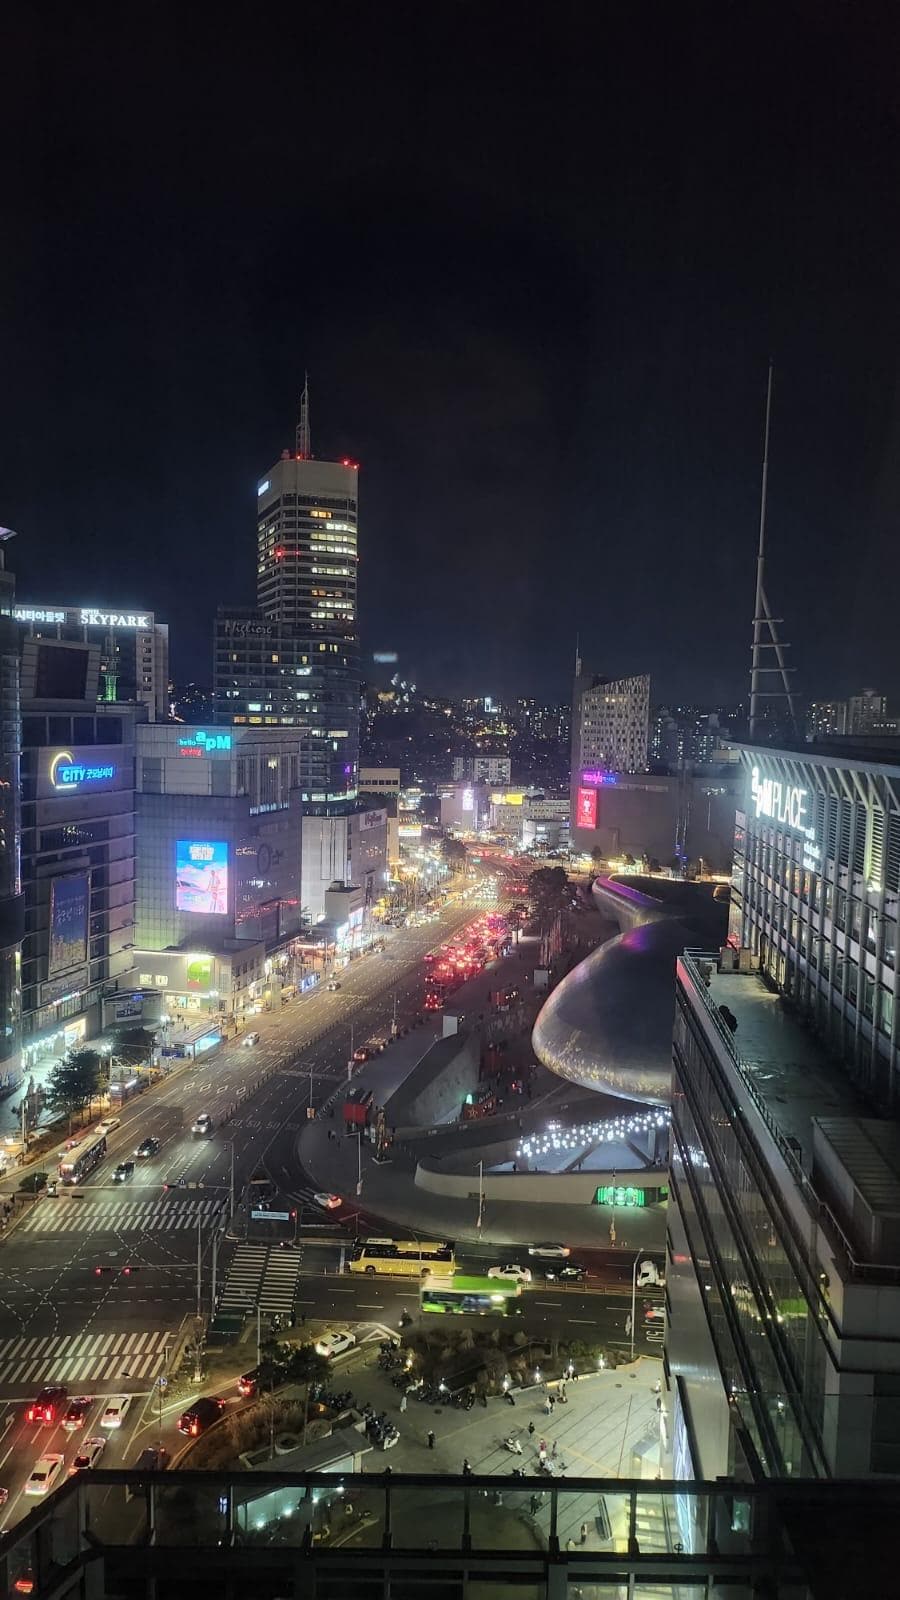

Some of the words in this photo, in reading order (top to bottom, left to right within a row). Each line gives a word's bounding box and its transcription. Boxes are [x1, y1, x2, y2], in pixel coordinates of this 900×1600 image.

[80, 614, 150, 628] SKYPARK
[195, 731, 231, 751] apM
[62, 768, 86, 782] CITY
[772, 781, 808, 832] PLACE
